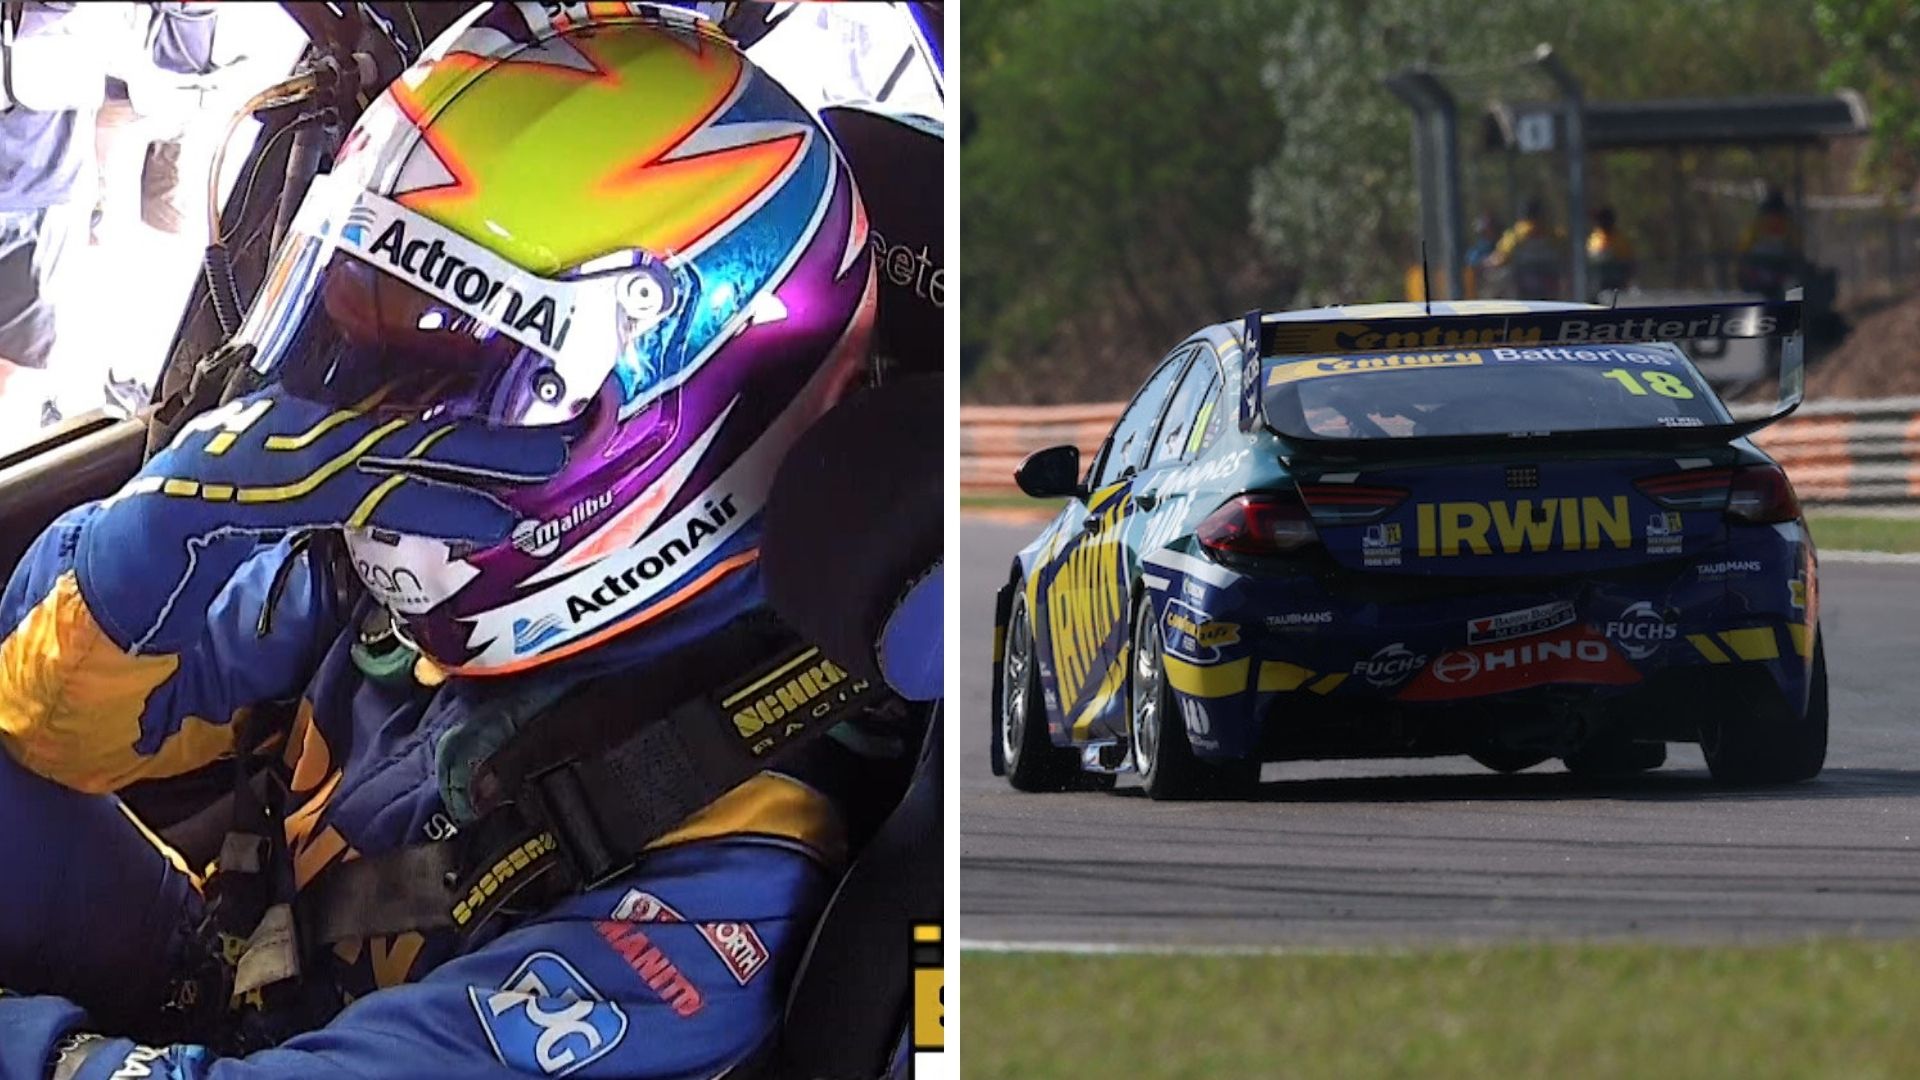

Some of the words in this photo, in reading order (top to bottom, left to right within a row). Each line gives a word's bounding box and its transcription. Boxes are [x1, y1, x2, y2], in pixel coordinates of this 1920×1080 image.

[1557, 314, 1778, 341] Batteries
[1493, 347, 1672, 367] Batteries
[1602, 368, 1695, 399] 18
[1416, 495, 1632, 557] IRWIN
[565, 493, 738, 624] ActronAir
[1696, 561, 1761, 575] TAUBMANS
[1047, 512, 1126, 717] IRWIN
[1266, 611, 1333, 625] TAUBMANS
[1605, 621, 1677, 641] FUCHS
[1353, 653, 1427, 676] FUCHS
[1485, 640, 1608, 671] HINO
[709, 922, 761, 976] ORTH
